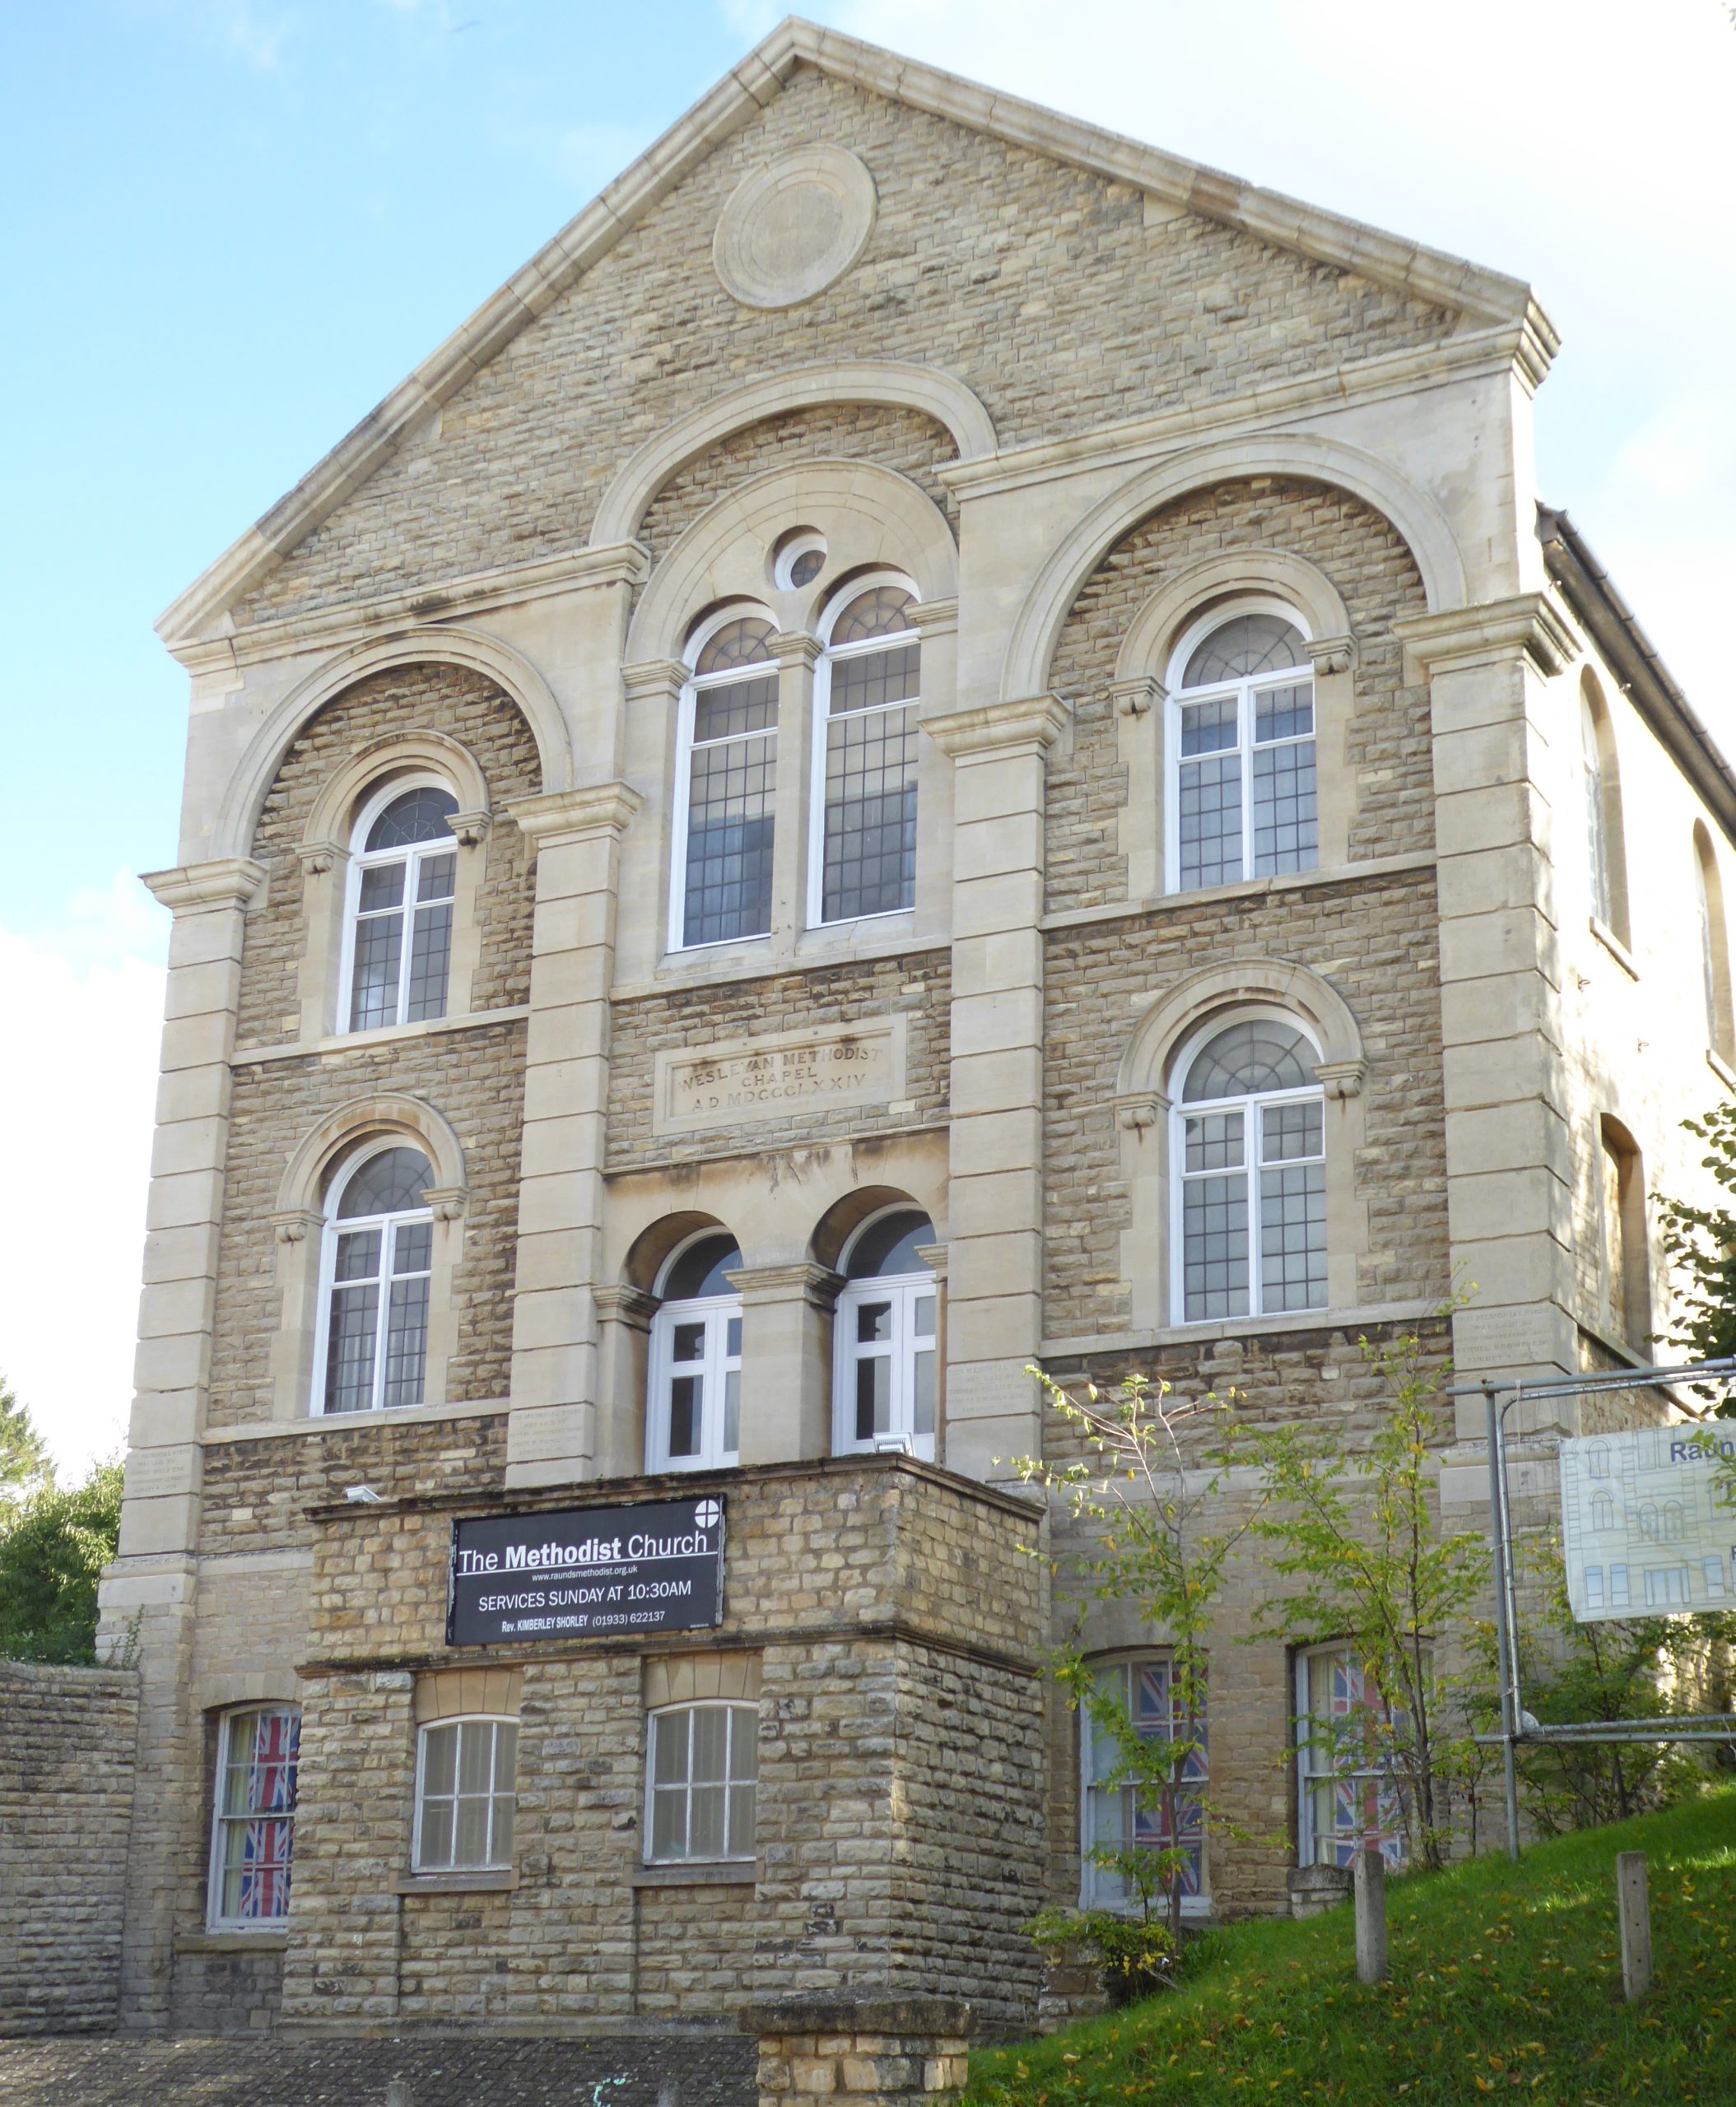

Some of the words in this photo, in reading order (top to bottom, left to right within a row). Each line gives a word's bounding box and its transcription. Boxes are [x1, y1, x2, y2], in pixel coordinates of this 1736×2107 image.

[677, 1056, 774, 1092] WESLEYAN
[783, 1047, 883, 1066] METHODIST
[742, 1067, 817, 1087] CHAPEL
[459, 1550, 498, 1572] The
[505, 1537, 621, 1569] Methodist
[628, 1530, 707, 1558] Church
[532, 1565, 638, 1581] www.raundsmethodist.org.uk
[478, 1592, 545, 1612] SERVICES
[549, 1587, 605, 1606] SUNDAY
[607, 1586, 623, 1602] AT
[627, 1580, 691, 1600] 10:30AM
[501, 1621, 516, 1633] Rev.
[517, 1617, 556, 1631] KIMBERLEY
[556, 1615, 589, 1629] SHORLEY
[592, 1613, 628, 1628] (01933)
[630, 1611, 665, 1624] 622137
